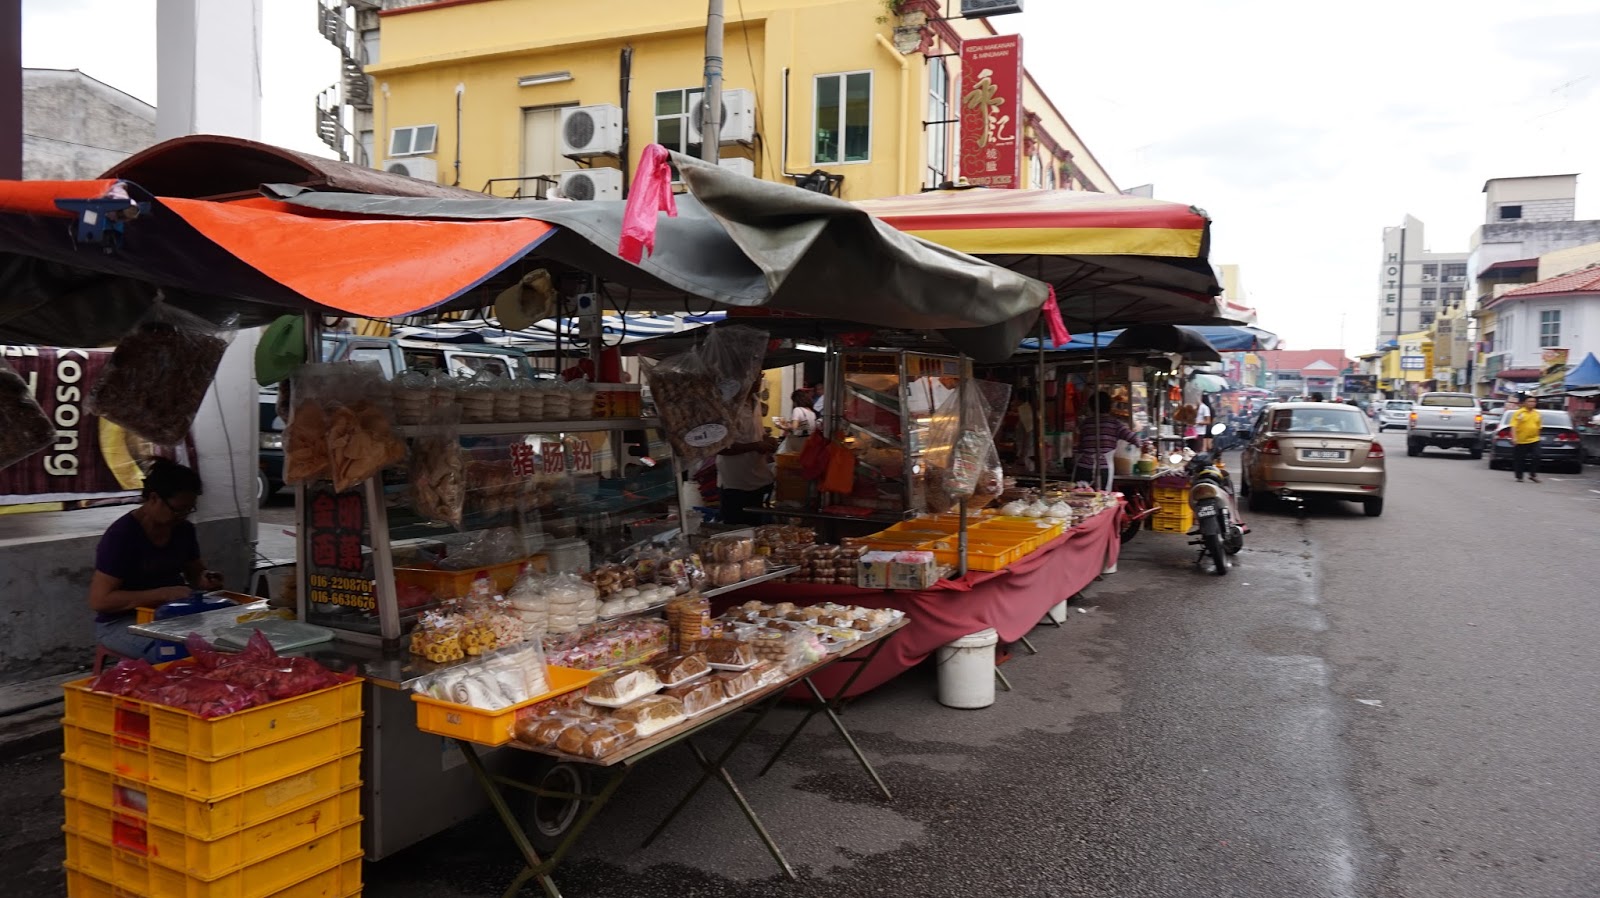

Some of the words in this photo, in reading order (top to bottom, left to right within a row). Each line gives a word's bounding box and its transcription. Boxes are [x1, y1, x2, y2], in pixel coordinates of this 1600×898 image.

[1385, 252, 1398, 316] HOTEL
[510, 440, 593, 476] 猪肠粉
[310, 574, 373, 593] 016-2208761
[311, 589, 375, 610] 016-6638676
